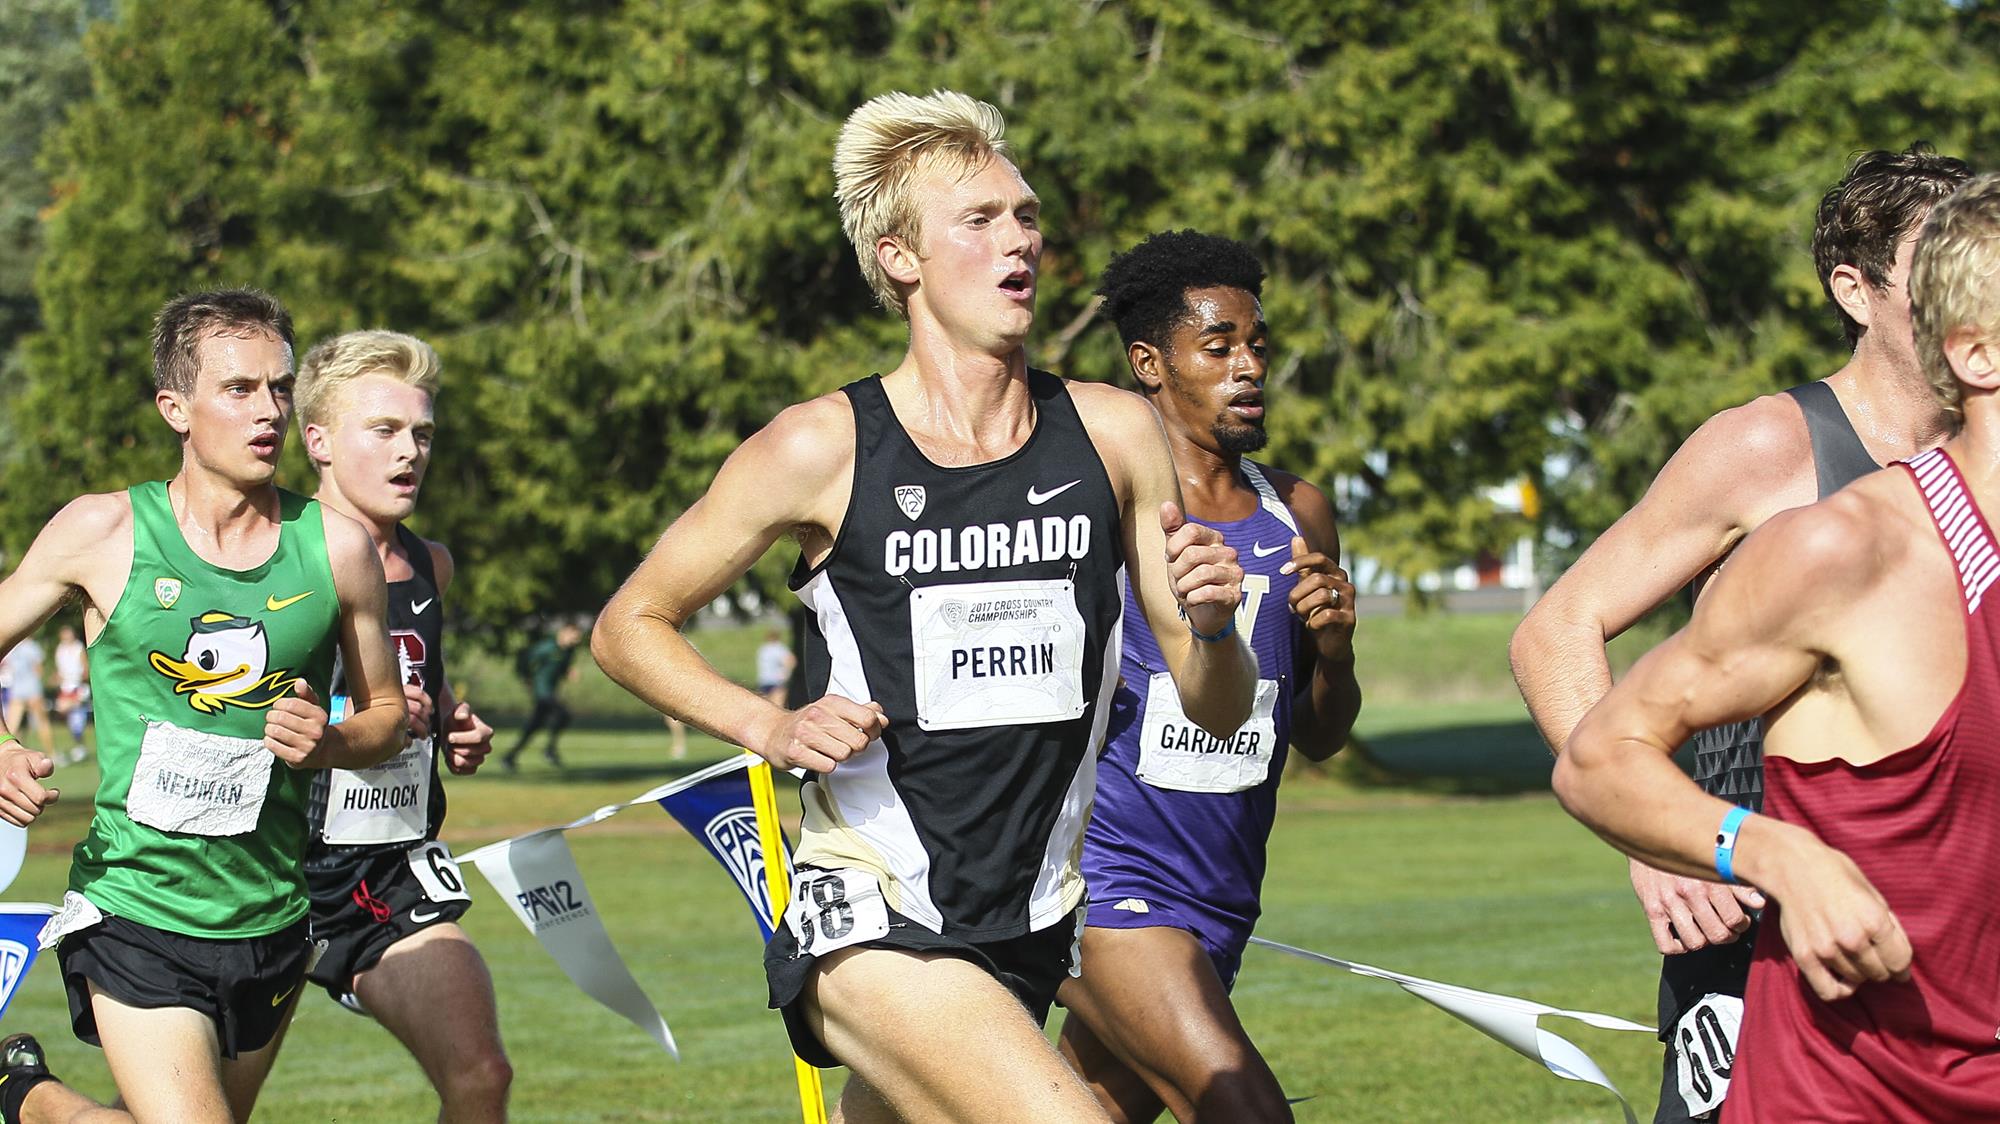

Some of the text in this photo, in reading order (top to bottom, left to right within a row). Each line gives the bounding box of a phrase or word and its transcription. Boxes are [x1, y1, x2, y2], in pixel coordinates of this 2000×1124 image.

[896, 488, 924, 507] PAC
[904, 500, 921, 513] 12
[884, 514, 1092, 577] COLORADO
[968, 608, 1038, 623] CHAMPIONSHIPS
[970, 598, 1054, 613] 2017 CROSS COUNTRY
[952, 642, 1054, 680] PERRIN
[1160, 723, 1261, 756] GARDNER
[156, 768, 244, 806] NEUMAN
[343, 783, 420, 810] HURLOCK
[1681, 1004, 1735, 1104] 60
